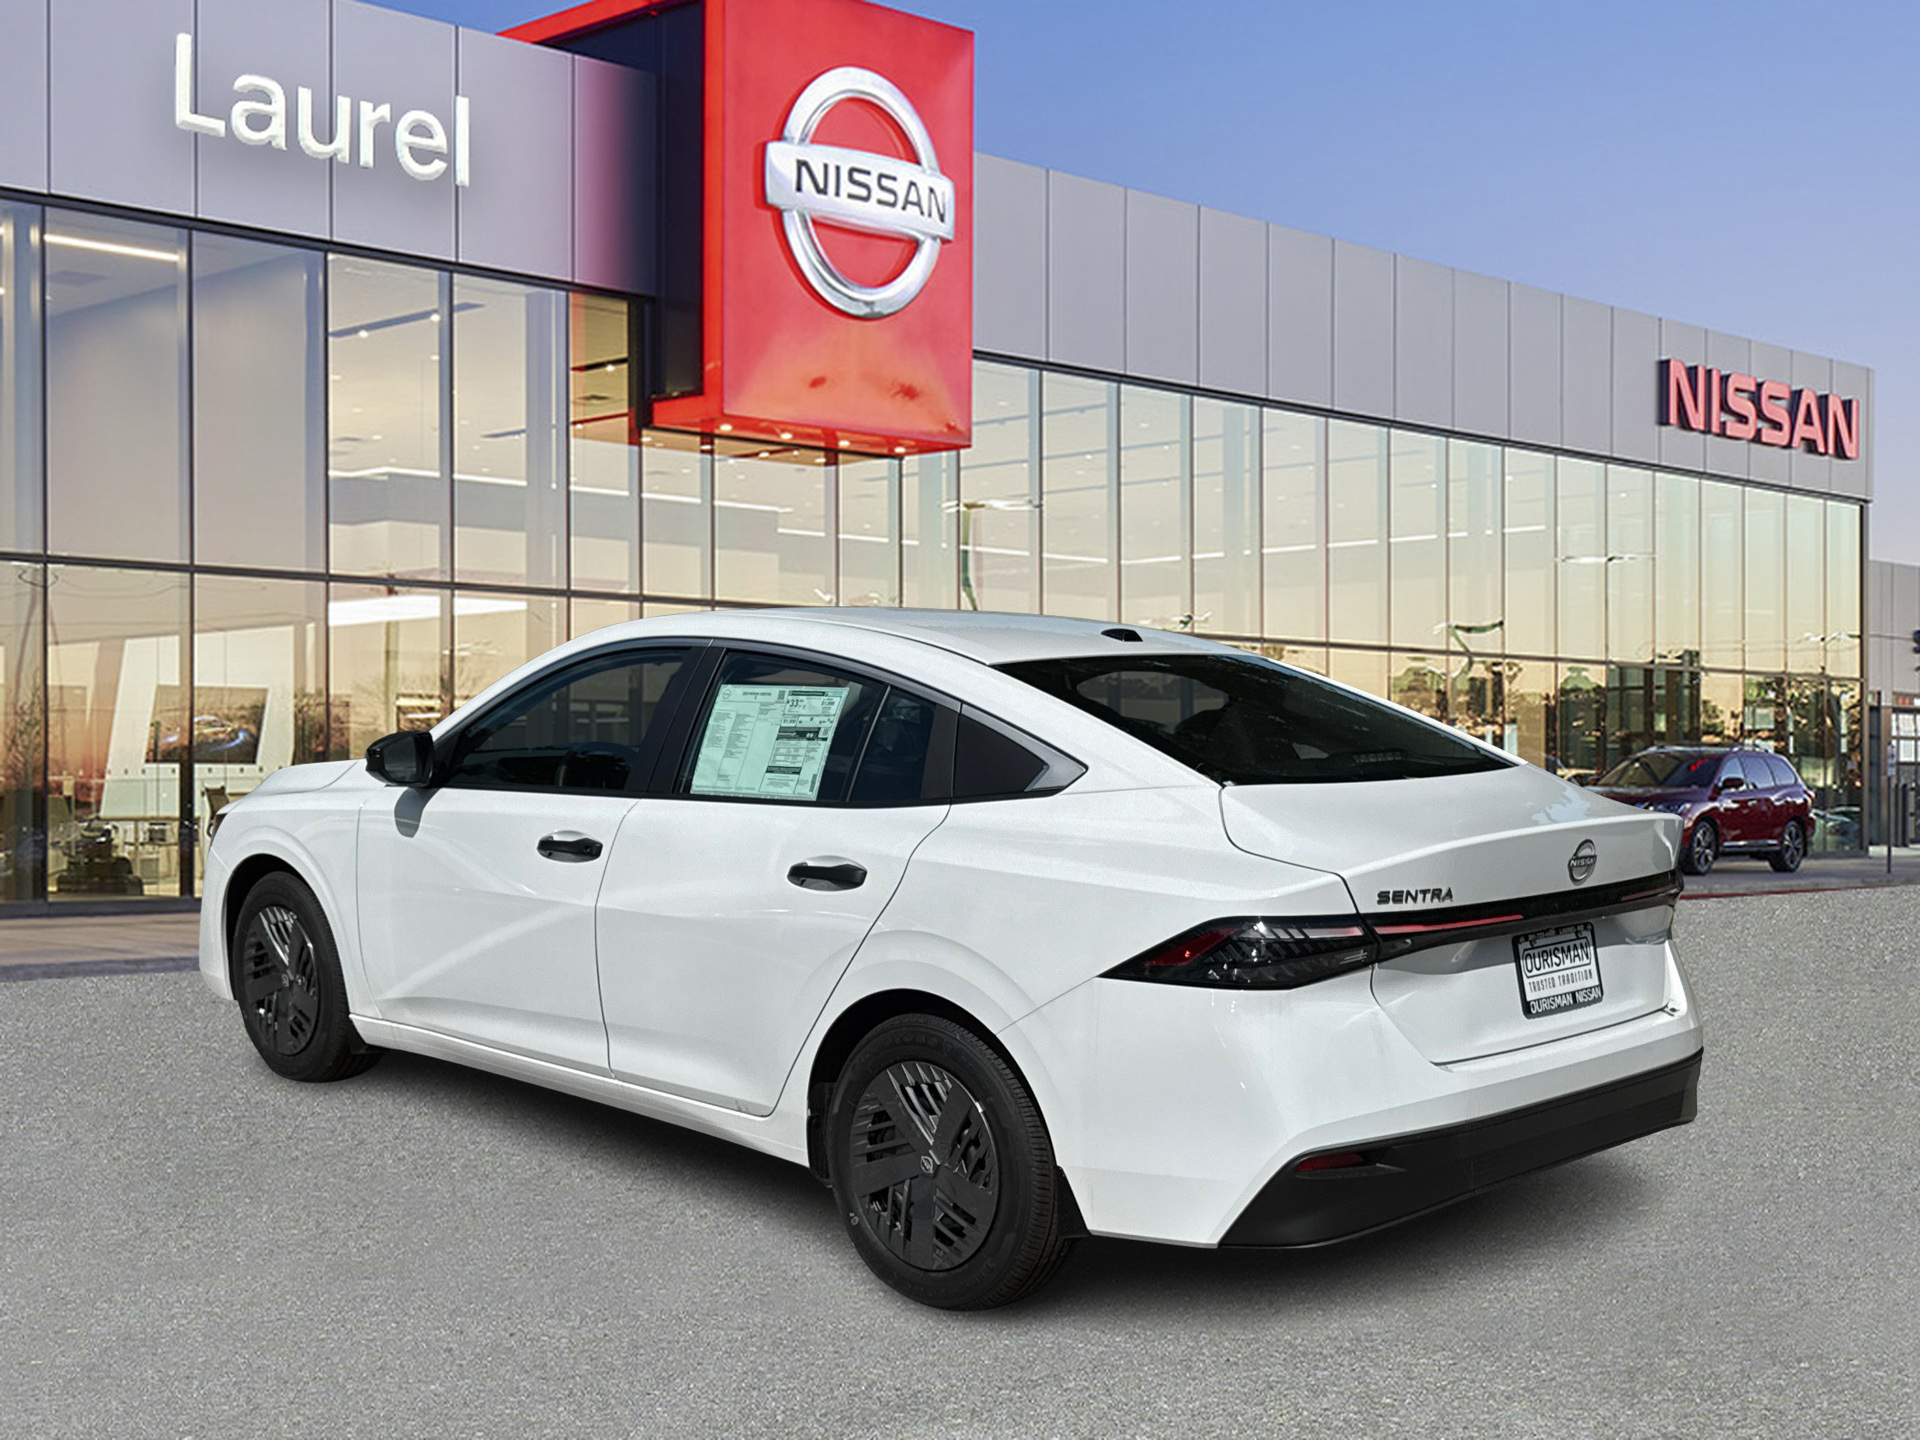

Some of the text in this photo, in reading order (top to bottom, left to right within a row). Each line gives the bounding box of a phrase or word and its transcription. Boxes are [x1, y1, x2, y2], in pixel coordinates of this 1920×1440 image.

[175, 32, 470, 188] Laurel
[795, 158, 947, 224] NISSAN
[1659, 358, 1860, 460] NISSAN
[1376, 886, 1454, 906] SENTRA
[1524, 941, 1590, 974] OURISMAN
[1528, 968, 1593, 994] TRUSTED TRADITION
[1529, 986, 1602, 1014] OURISMAN NISSAN
